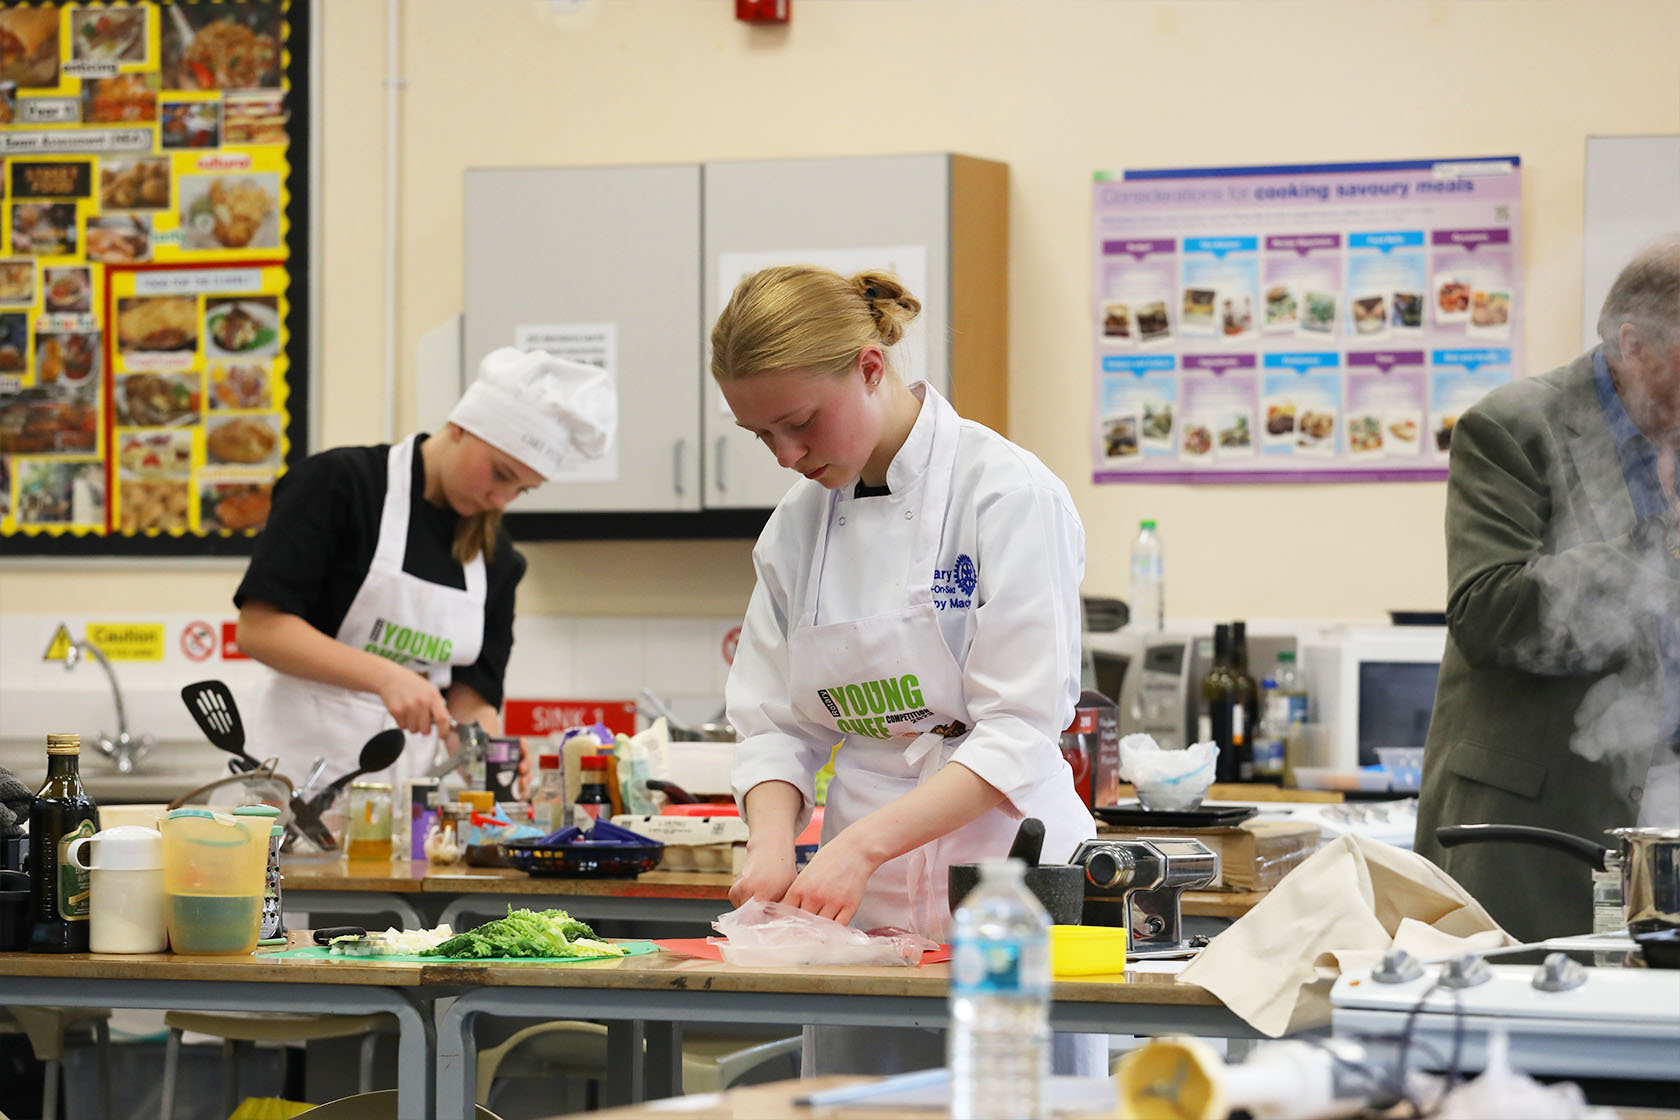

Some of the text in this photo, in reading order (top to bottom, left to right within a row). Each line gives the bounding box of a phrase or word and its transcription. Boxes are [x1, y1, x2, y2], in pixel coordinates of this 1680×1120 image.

[1254, 183, 1329, 201] cooking
[1336, 180, 1410, 199] savoury
[1416, 174, 1475, 194] meals
[383, 621, 453, 664] YOUNG
[828, 674, 925, 717] YOUNG
[533, 706, 587, 731] SINK
[886, 708, 930, 724] COMPETITION
